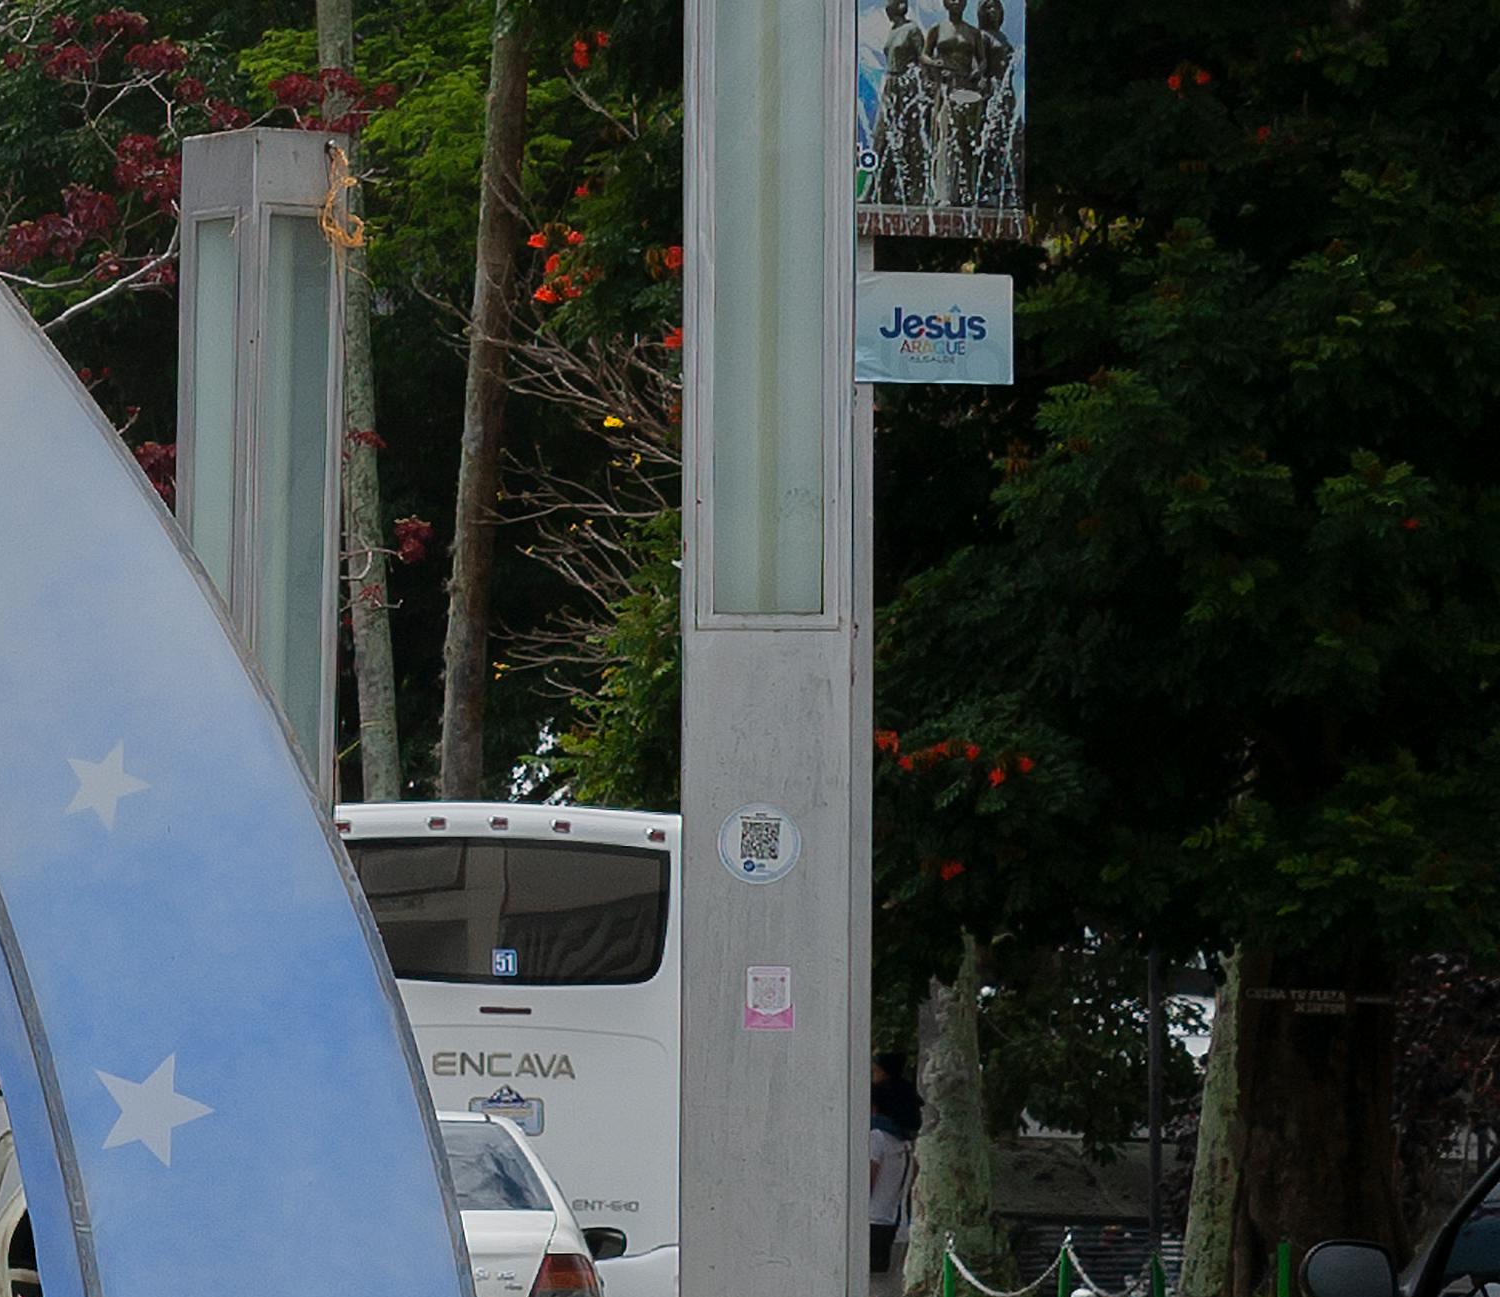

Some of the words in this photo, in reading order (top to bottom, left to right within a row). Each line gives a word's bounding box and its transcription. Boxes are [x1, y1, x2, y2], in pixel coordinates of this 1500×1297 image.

[900, 340, 966, 356] ARAQUE
[496, 953, 514, 974] 51
[432, 1051, 576, 1080] ENCAVA
